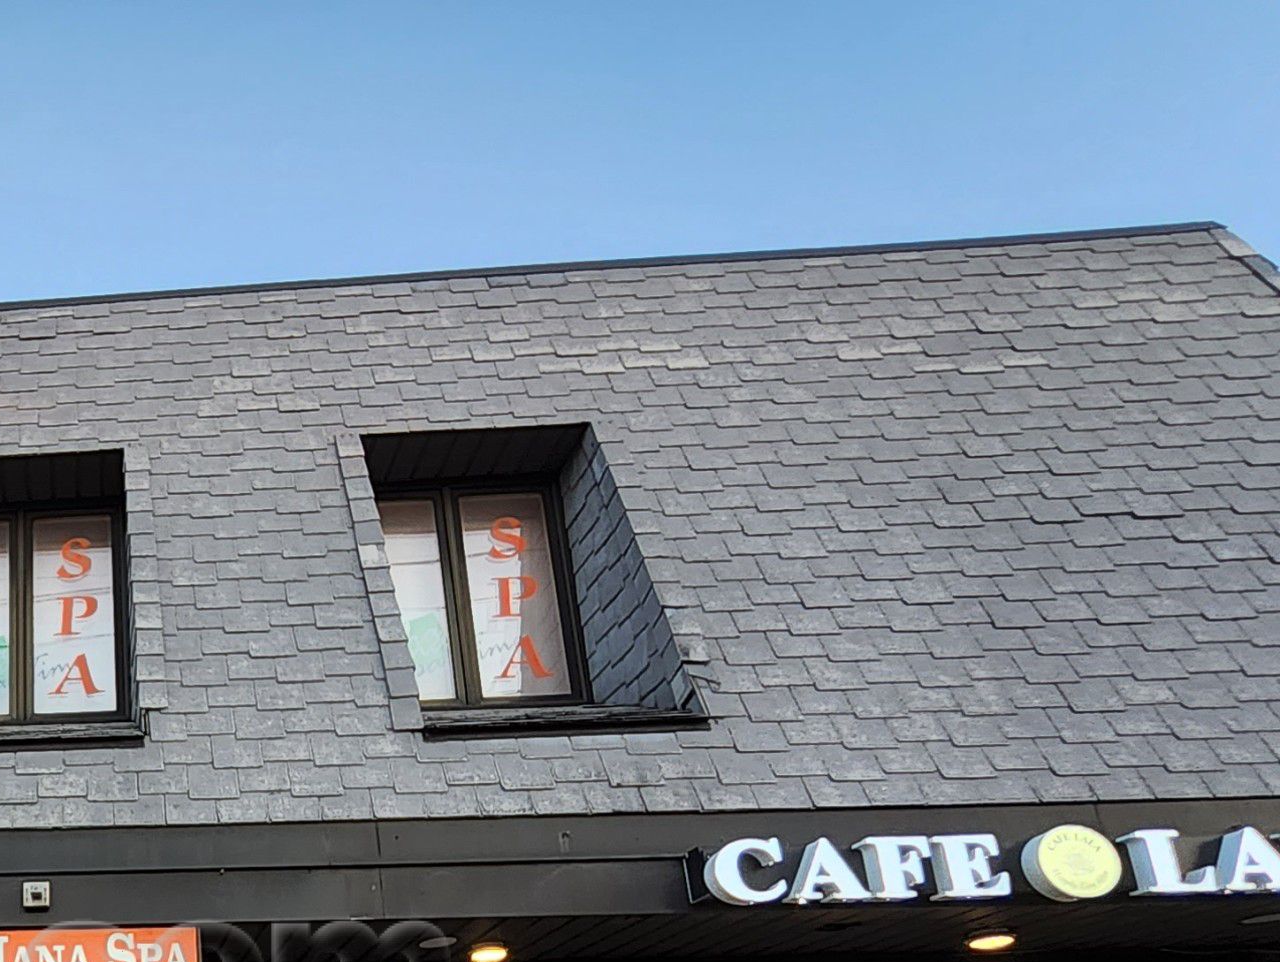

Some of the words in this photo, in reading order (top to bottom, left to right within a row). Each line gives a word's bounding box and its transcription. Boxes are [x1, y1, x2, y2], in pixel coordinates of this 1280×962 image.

[47, 537, 106, 697] SPA
[486, 516, 554, 679] SPA
[704, 834, 1012, 904] CAFE
[1117, 826, 1280, 896] LA
